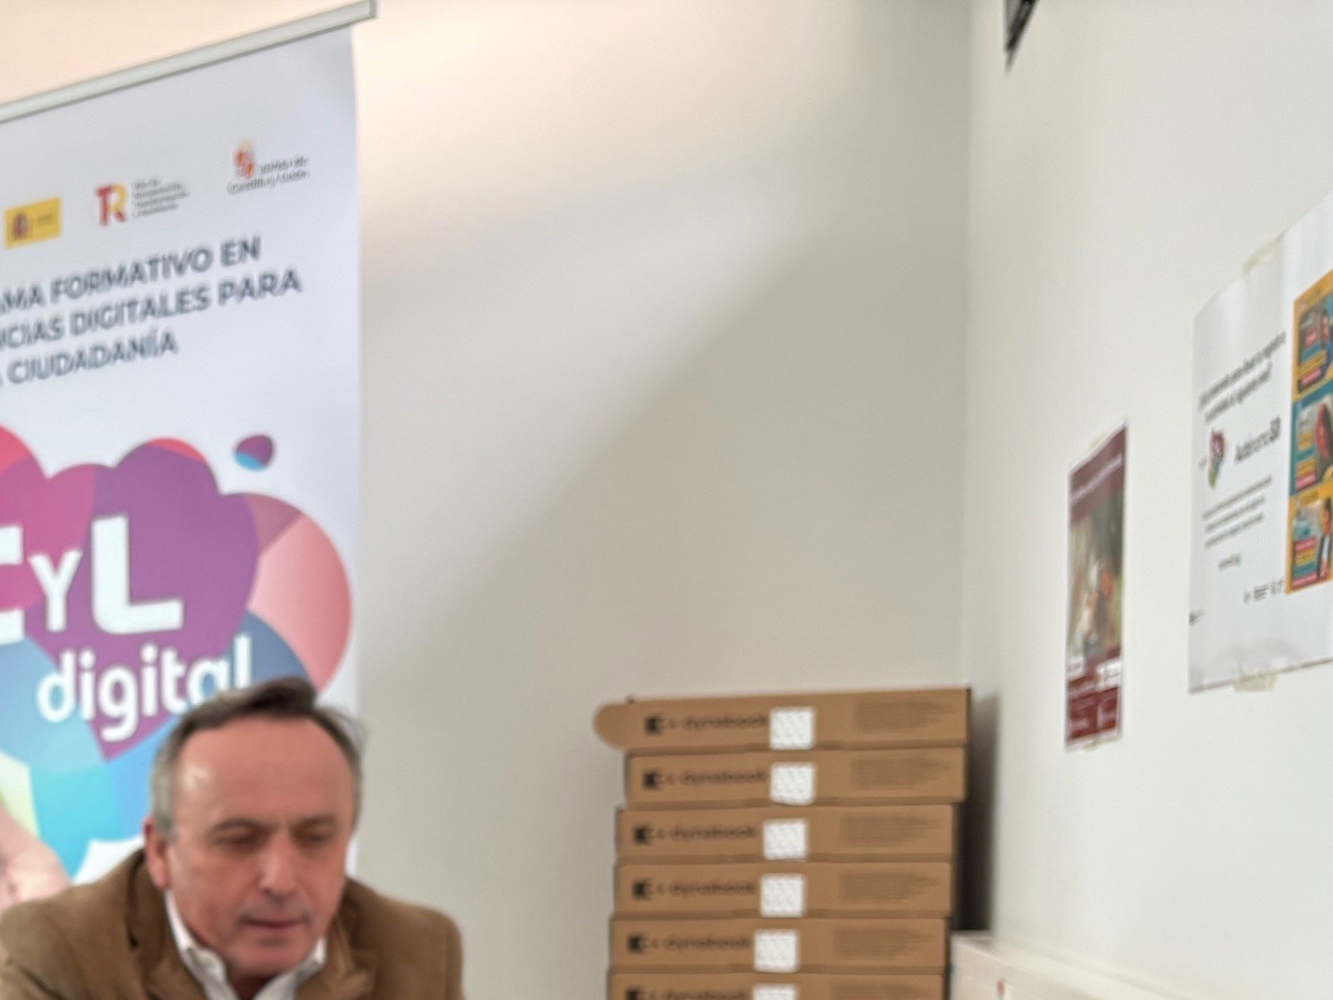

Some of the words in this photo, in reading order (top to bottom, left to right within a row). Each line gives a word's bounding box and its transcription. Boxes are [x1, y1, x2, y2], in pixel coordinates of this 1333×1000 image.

[51, 245, 213, 300] FORMATIVO
[219, 235, 263, 268] EN
[70, 284, 212, 335] DIGITALES
[218, 266, 303, 307] PARA
[7, 330, 180, 384] CIUDADANÍA
[36, 634, 253, 744] digital
